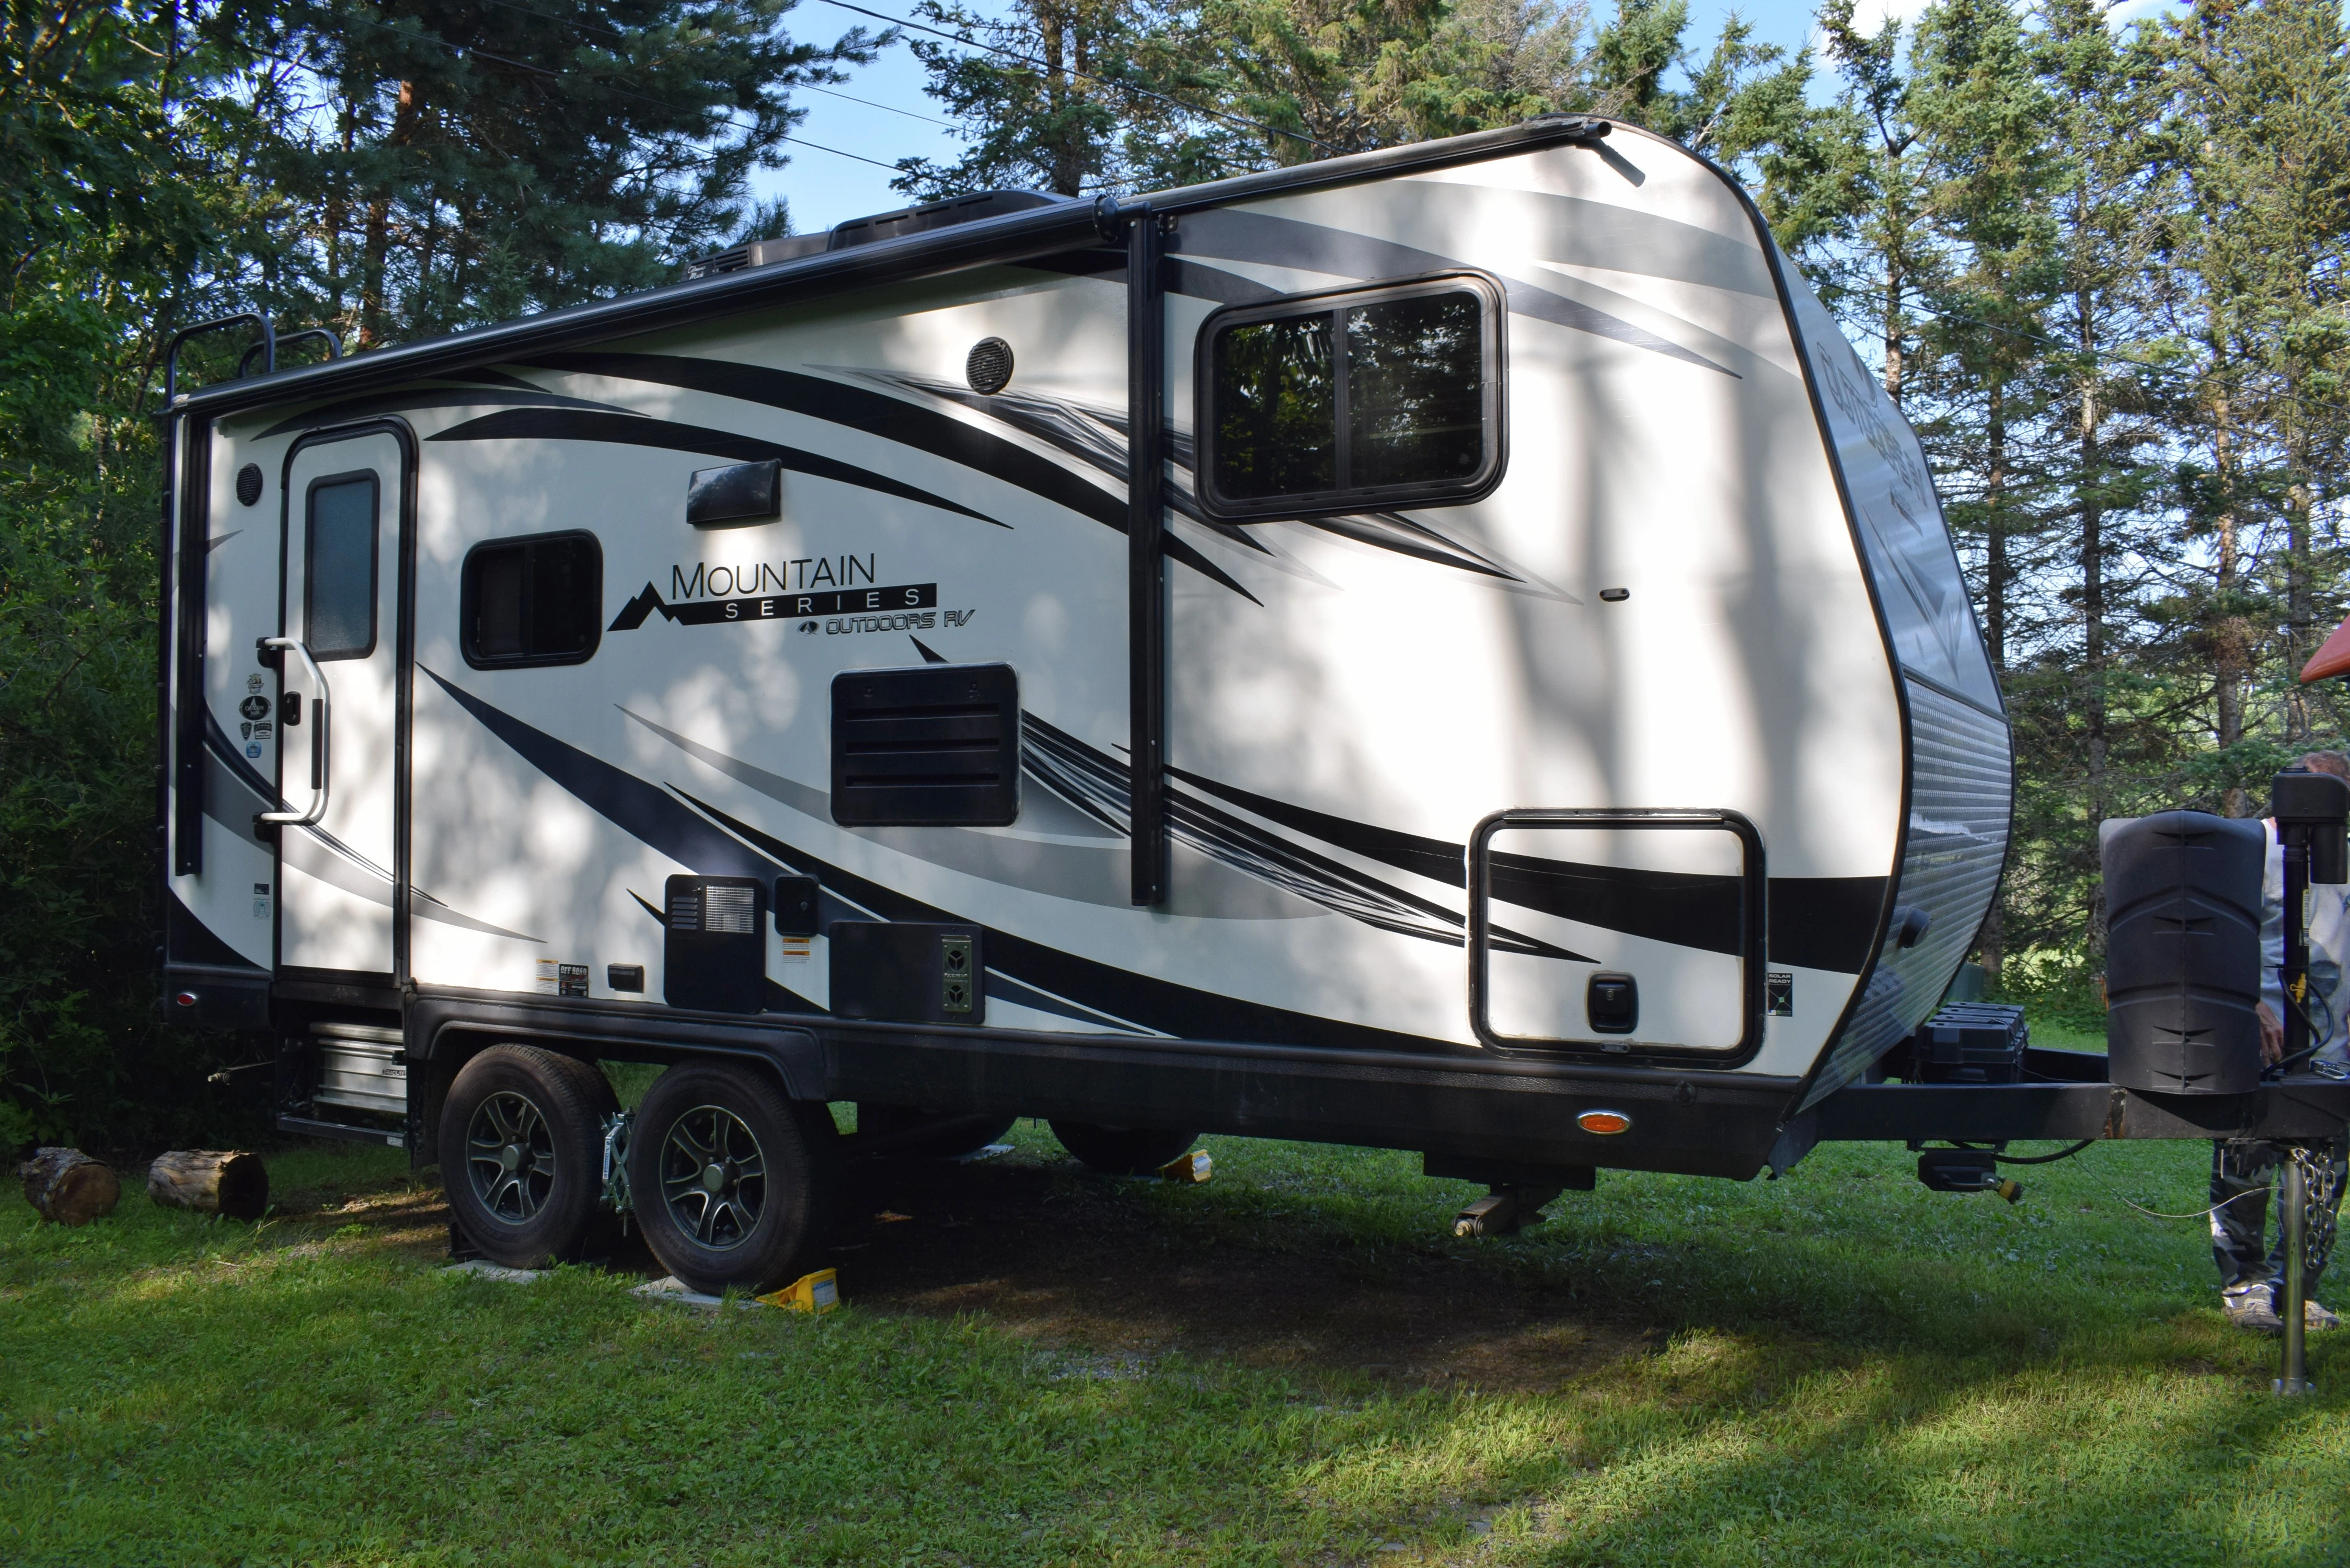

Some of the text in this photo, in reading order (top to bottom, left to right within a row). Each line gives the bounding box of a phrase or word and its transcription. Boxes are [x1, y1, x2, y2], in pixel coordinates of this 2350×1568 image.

[672, 552, 874, 600] MOUNTAIN
[725, 589, 919, 619] SERIES
[825, 609, 976, 635] OUTDOORS RV
[560, 965, 572, 974] OFF
[572, 966, 587, 976] ROAD
